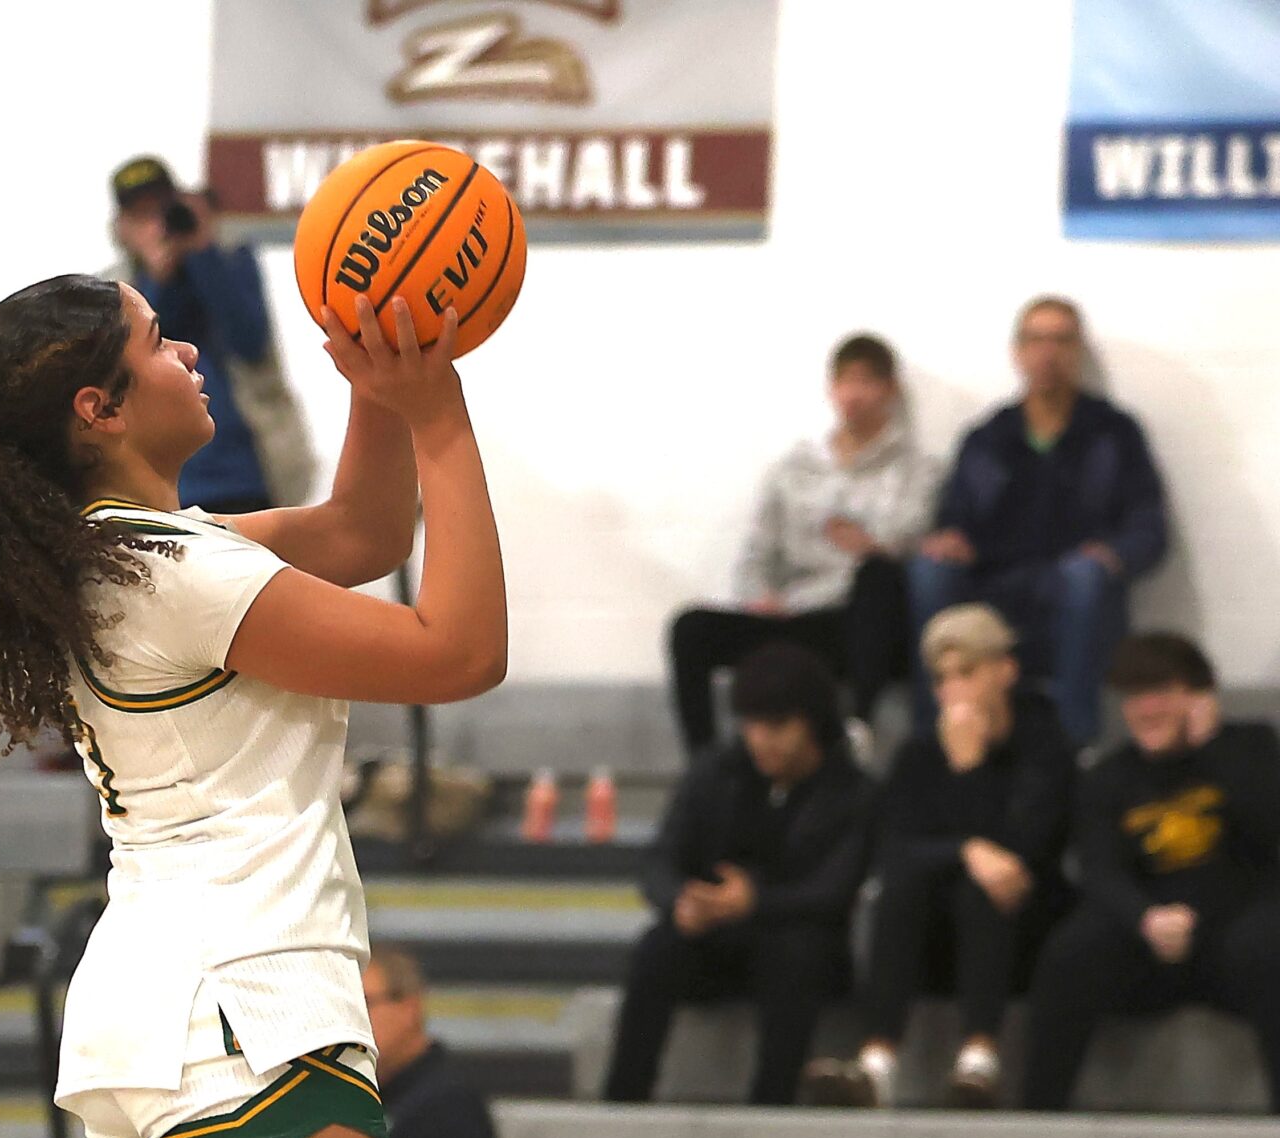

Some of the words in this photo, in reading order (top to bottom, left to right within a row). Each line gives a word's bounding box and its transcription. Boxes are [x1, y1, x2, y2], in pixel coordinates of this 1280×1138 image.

[264, 138, 707, 211] WEHALL
[336, 169, 449, 292] Wilson
[426, 227, 488, 314] EVO
